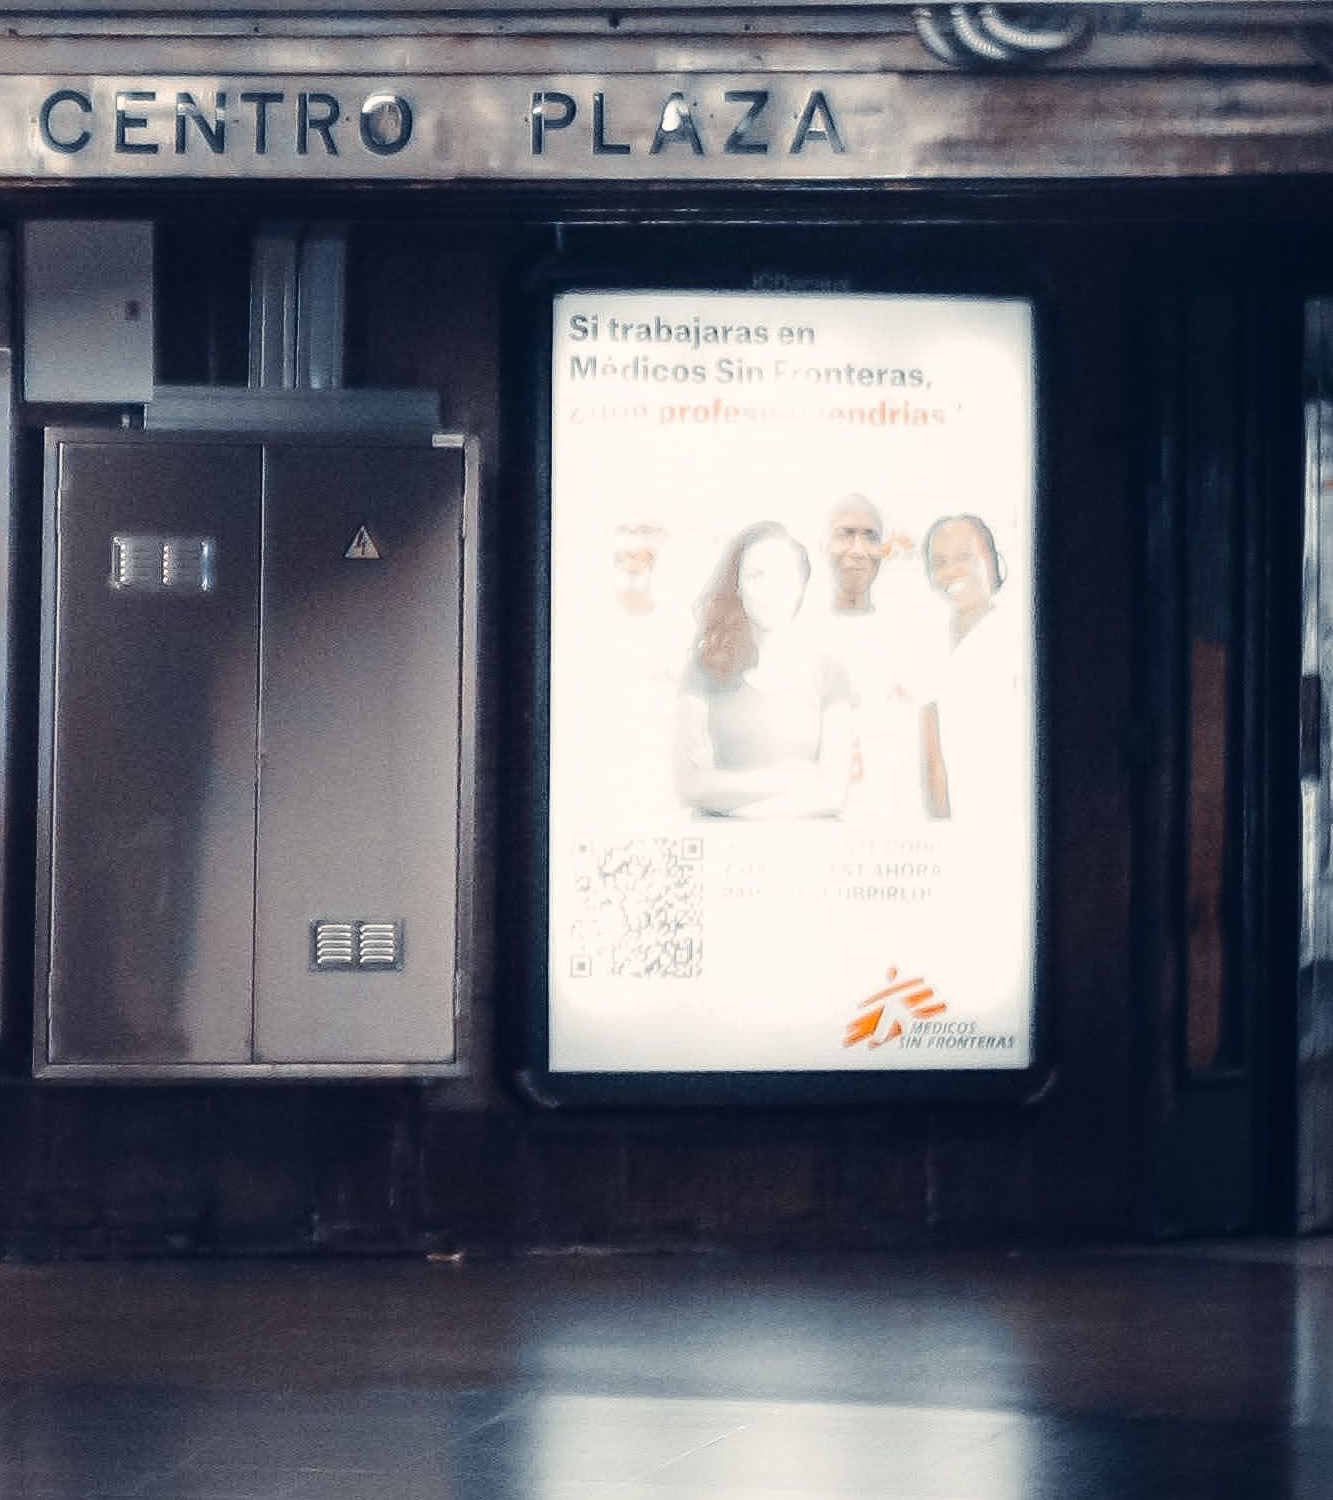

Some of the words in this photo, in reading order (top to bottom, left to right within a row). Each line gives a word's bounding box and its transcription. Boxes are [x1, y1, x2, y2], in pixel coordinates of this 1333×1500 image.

[38, 88, 414, 155] CENTRO
[532, 90, 847, 155] PLAZA
[569, 313, 598, 342] Si
[608, 316, 769, 349] trabajaras
[778, 323, 816, 345] en
[569, 353, 707, 383] Médicos
[716, 358, 763, 384] Sin
[774, 360, 933, 390] Fronteras,
[900, 1034, 922, 1049] SIN
[927, 1034, 1015, 1049] FRONTERAS
